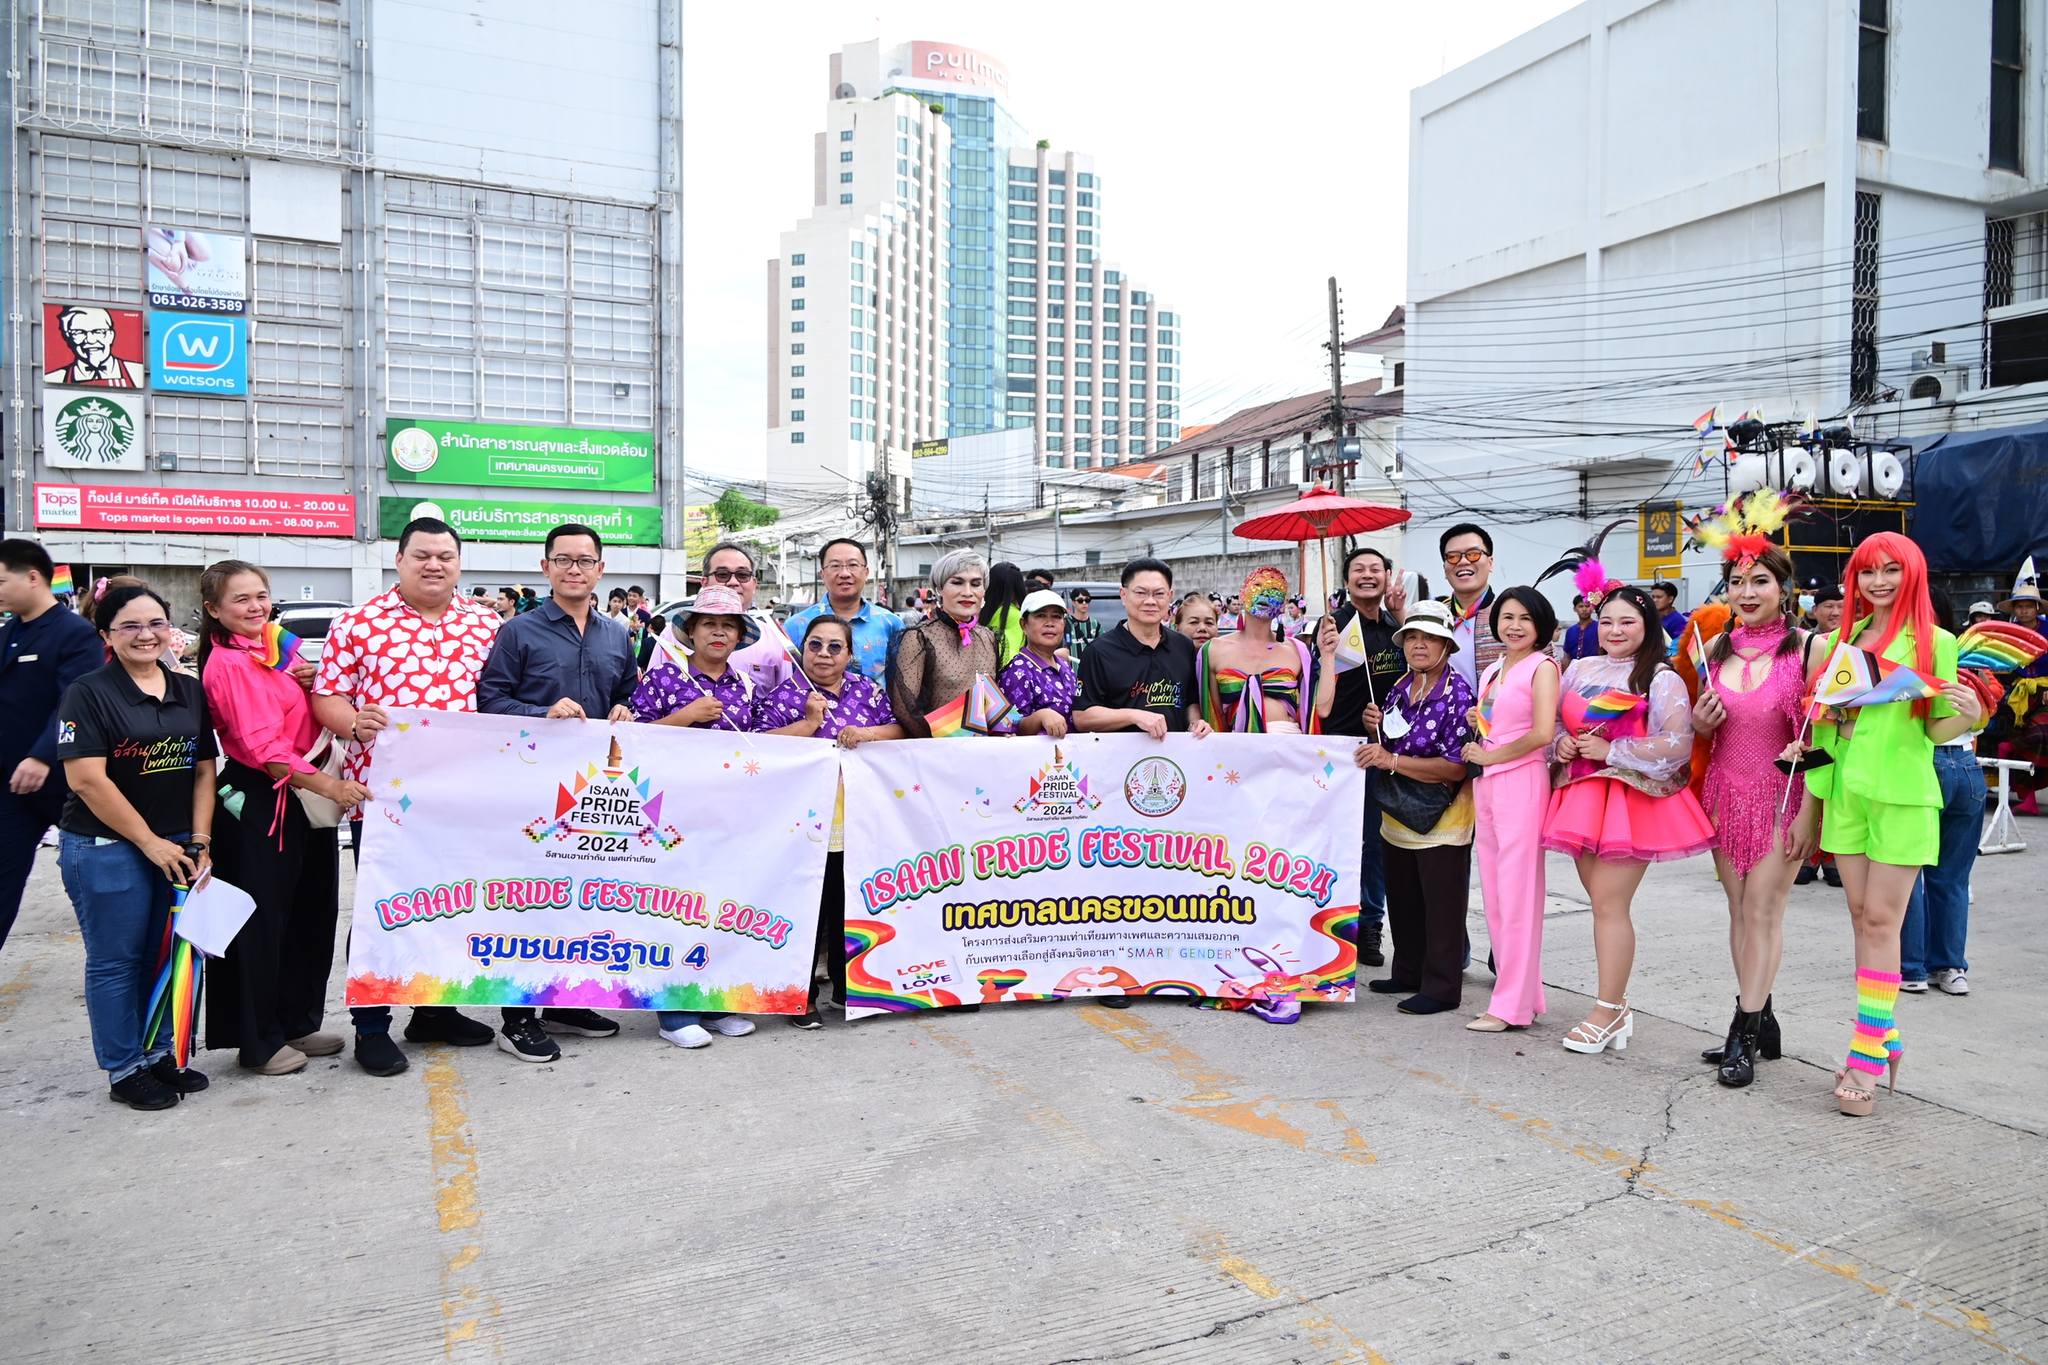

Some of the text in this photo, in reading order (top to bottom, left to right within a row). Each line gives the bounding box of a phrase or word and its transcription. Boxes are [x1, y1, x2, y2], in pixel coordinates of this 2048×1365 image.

[152, 294, 243, 312] 061-026-3589
[163, 374, 236, 388] watsons
[440, 432, 648, 459] สำนักสาธารณสุขและสิ่งแวดล้อม
[495, 460, 599, 476] เทศบาลนครขอนแก่น
[41, 492, 78, 507] Tops
[88, 490, 122, 504] ท็อปส์
[126, 492, 169, 505] มาร์เก็ต
[172, 494, 242, 507] เปิดให้บริการ
[245, 499, 277, 509] 10.00
[280, 500, 291, 509] น.
[304, 501, 335, 511] 20.00
[338, 503, 349, 511] น.
[41, 507, 78, 516] market
[450, 507, 633, 528] ศูนย์บริการสาธารณสุขที่ 1
[99, 512, 128, 523] Tops
[131, 514, 170, 523] market
[173, 514, 182, 523] is
[185, 516, 213, 526] open
[216, 516, 246, 525] 10.00
[249, 518, 272, 526] a.m.
[283, 518, 313, 528] 08.00
[316, 520, 339, 529] p.m.
[589, 785, 630, 797] ISAAN
[1038, 791, 1079, 799] FESTIVAL
[1043, 782, 1076, 791] PRIDE
[580, 796, 641, 813] PRIDE
[1043, 806, 1072, 816] 2024
[571, 811, 644, 827] FESTIVAL
[577, 835, 629, 853] 2024
[545, 850, 656, 864] อีสานเฮาเท่ากัน เพศเท่าเทียม
[863, 828, 1336, 911] ISAAN PRIDE FESTIVAL 2024
[378, 878, 791, 947] ISAAN PRIDE FESTIVAL 2024
[944, 887, 1255, 930] เทศบาลนครขอนแก่น
[961, 930, 1240, 948] โครงการส่งเสริมความเท่าเทียมทางเพศและความเสมอภาค
[469, 932, 708, 972] ชุมชนศรีฐาน 4
[965, 948, 1115, 965] กับเพศทางเลือกสู่สังคมจิตอาสา
[897, 960, 947, 976] LOVE
[902, 974, 952, 990] LOVE
